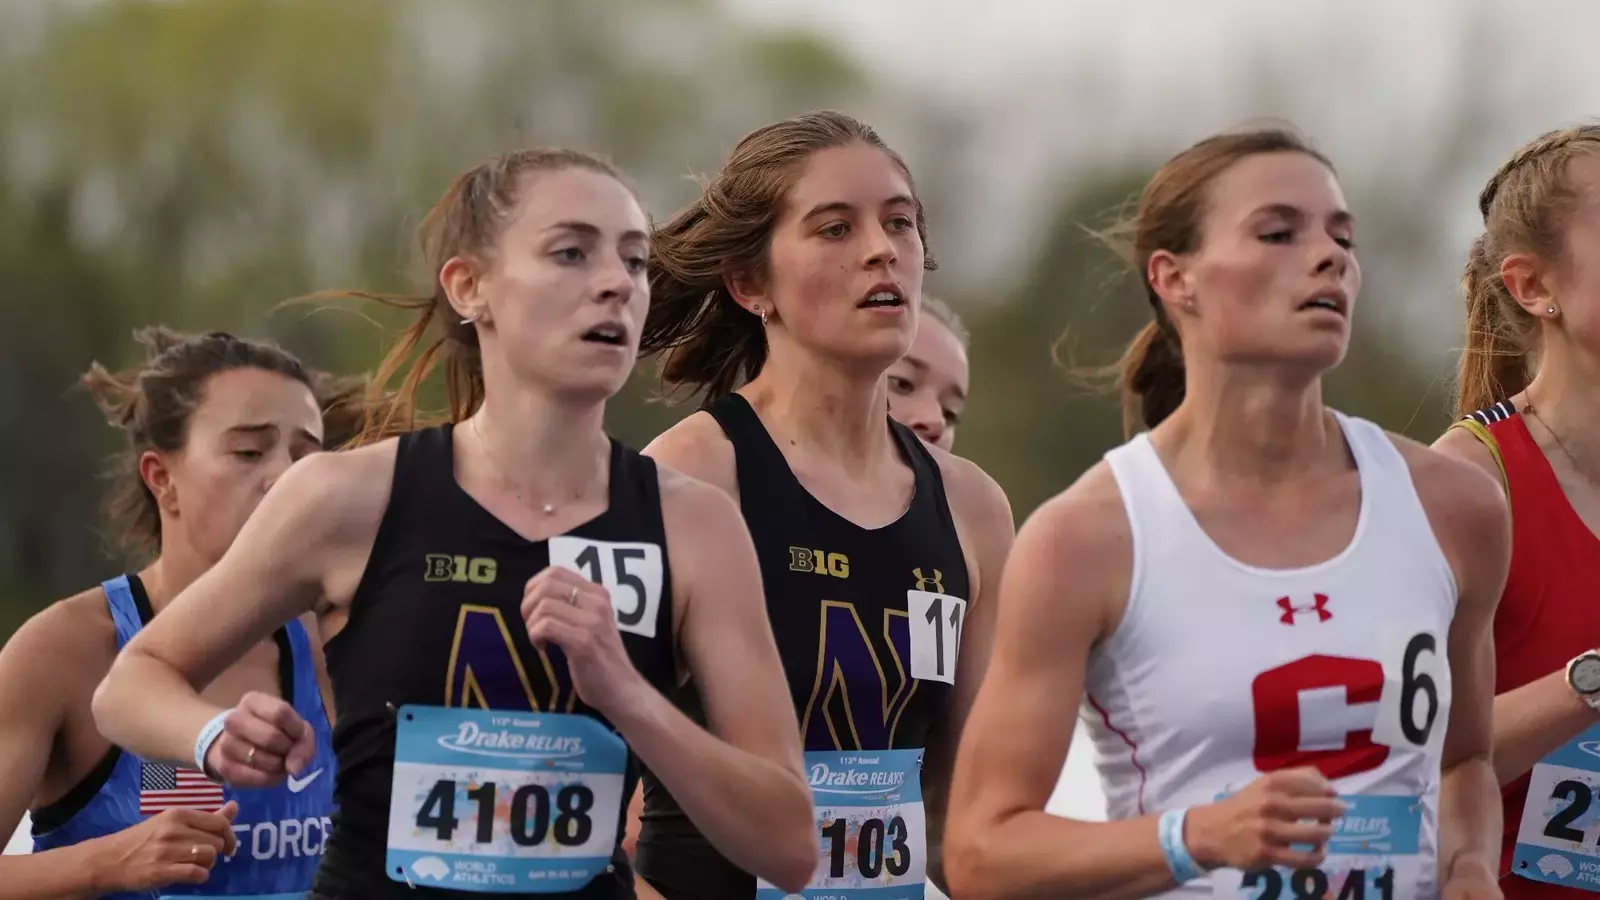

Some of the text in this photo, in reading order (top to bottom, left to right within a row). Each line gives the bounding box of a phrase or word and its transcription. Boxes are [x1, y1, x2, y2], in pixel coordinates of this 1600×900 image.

[575, 545, 646, 626] 15
[925, 598, 960, 676] 11
[1400, 632, 1438, 746] 6
[455, 721, 524, 749] Drake
[525, 735, 582, 751] RELAYS
[809, 763, 904, 786] Drake RELAYS
[415, 779, 594, 847] 4108
[1543, 779, 1600, 847] 2
[453, 872, 516, 886] ATHLETICS
[454, 861, 496, 873] WORLD
